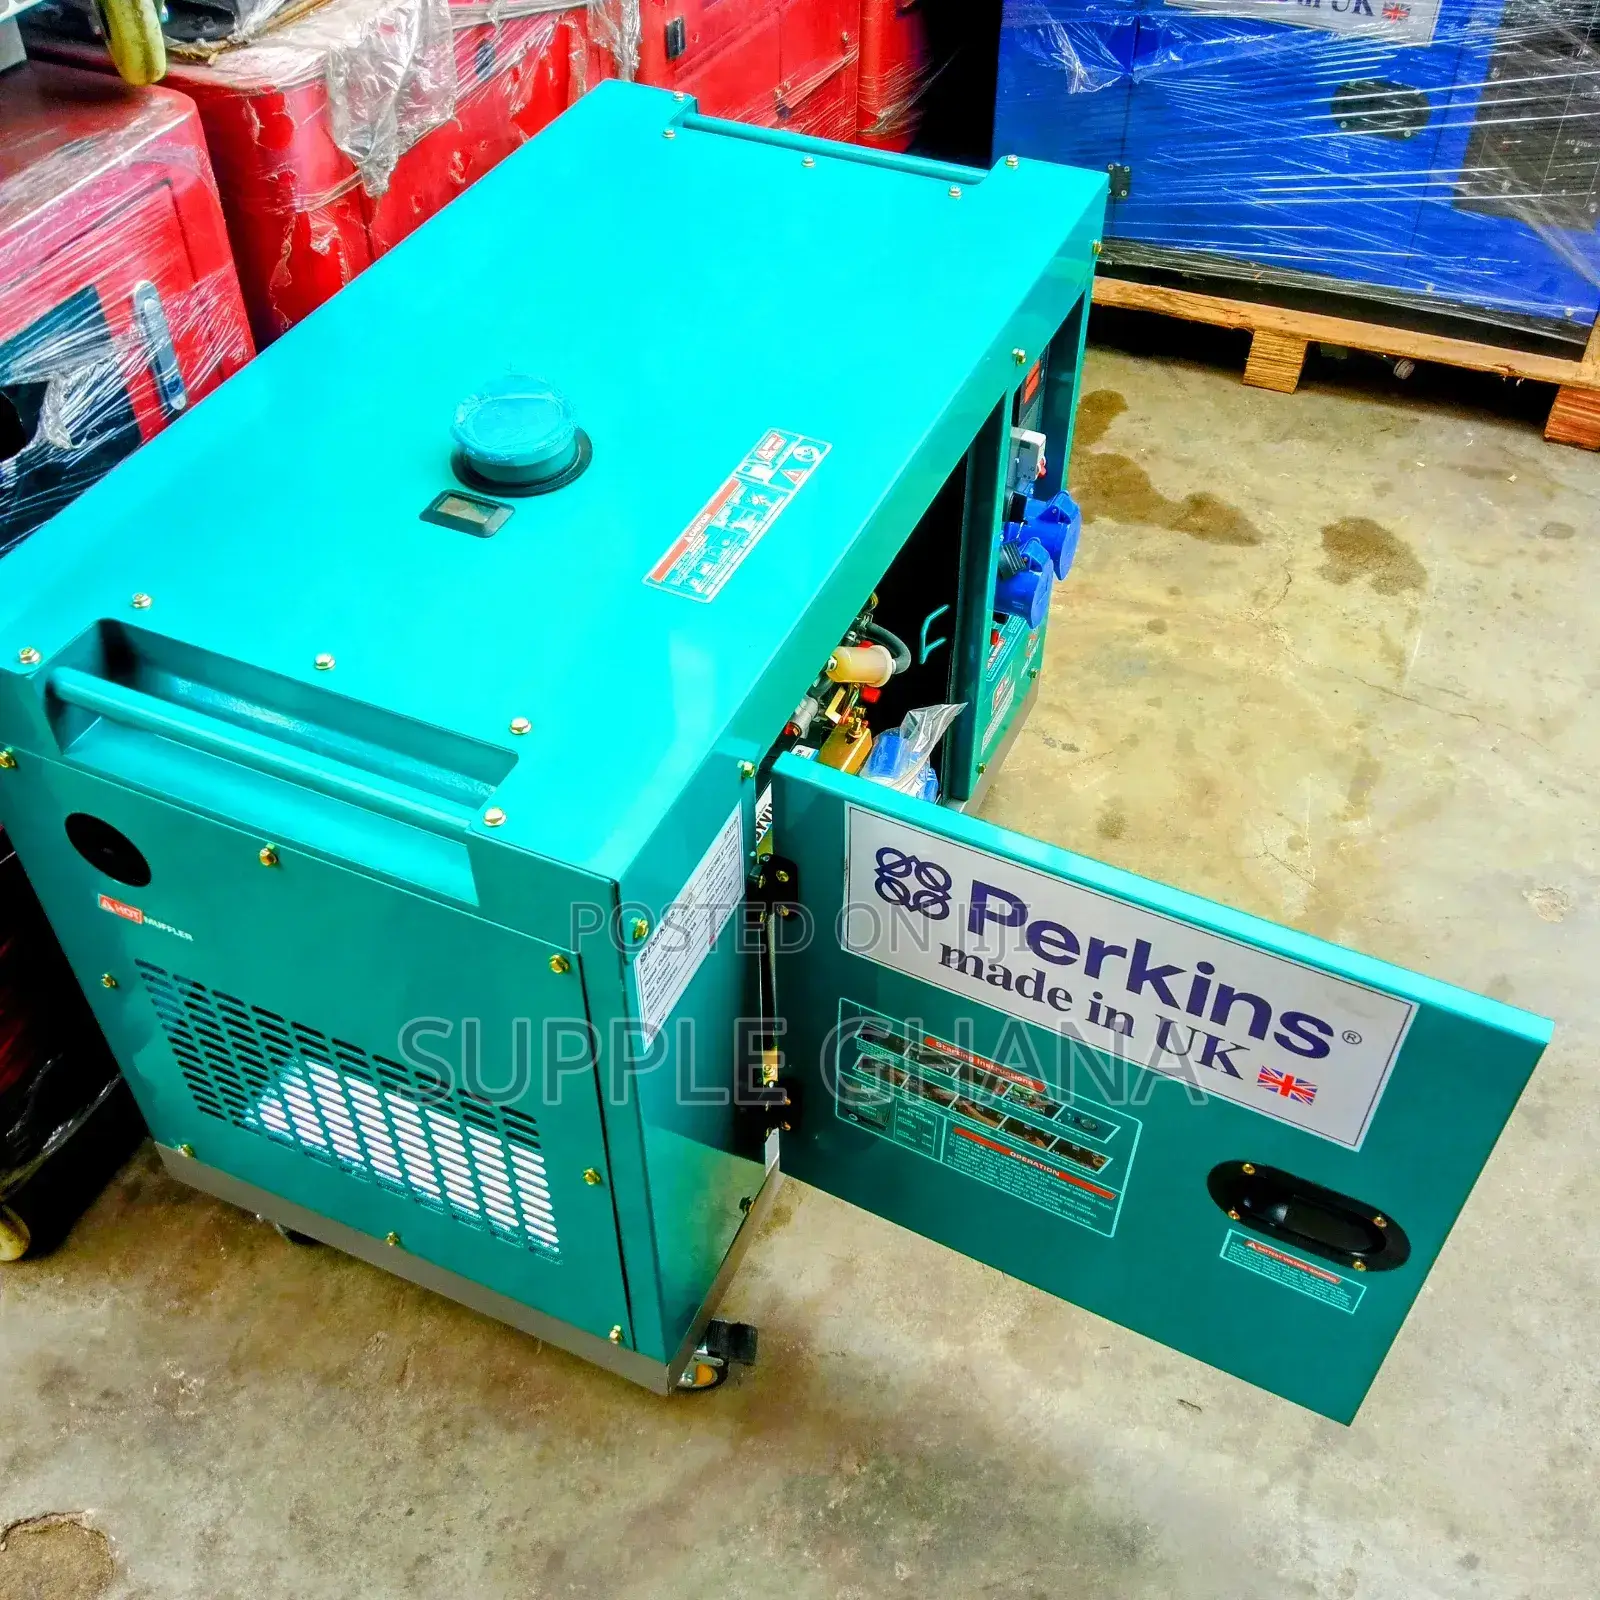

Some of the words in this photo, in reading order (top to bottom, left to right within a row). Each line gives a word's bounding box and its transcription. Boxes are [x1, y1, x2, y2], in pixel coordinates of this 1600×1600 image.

[143, 915, 194, 942] MUFFLER
[967, 879, 1334, 1060] Perkins
[938, 942, 1074, 1010] made
[1088, 990, 1135, 1039] in
[1154, 1014, 1254, 1081] UK
[935, 1041, 975, 1063] Starting
[976, 1057, 1034, 1088] Instructions
[1010, 1152, 1060, 1177] OPERATION
